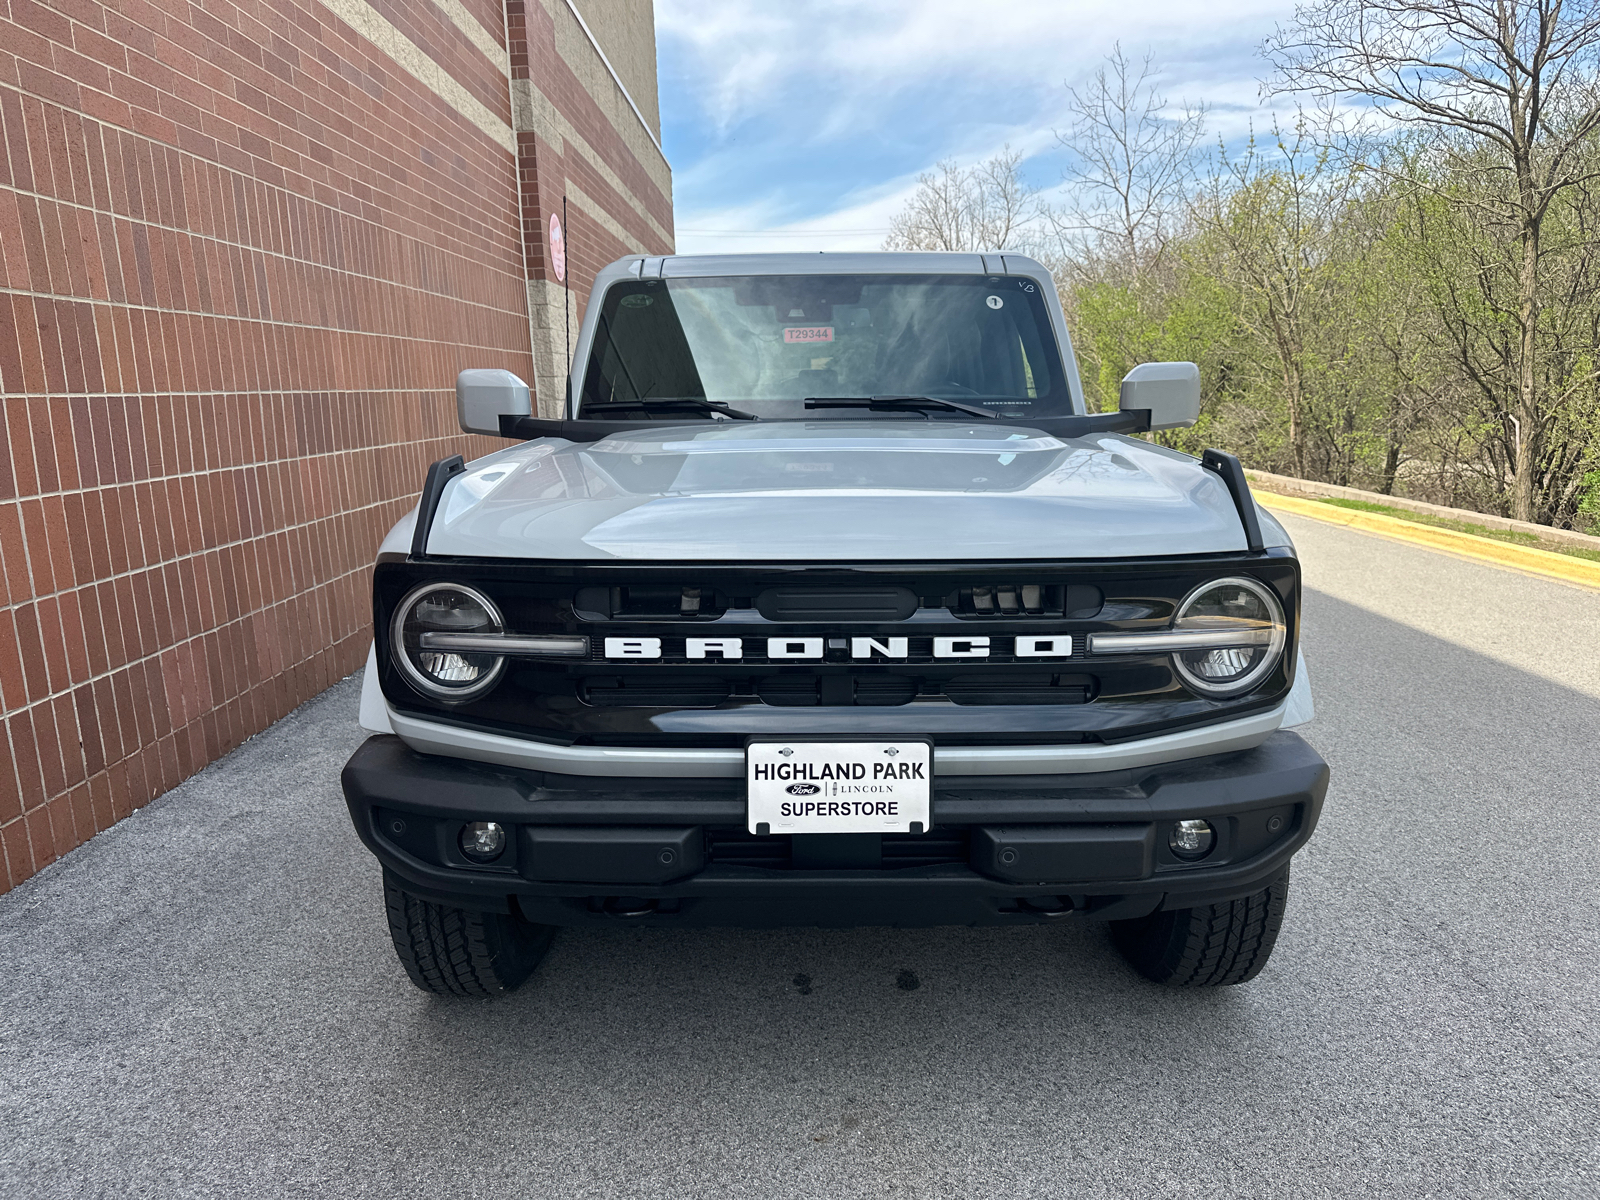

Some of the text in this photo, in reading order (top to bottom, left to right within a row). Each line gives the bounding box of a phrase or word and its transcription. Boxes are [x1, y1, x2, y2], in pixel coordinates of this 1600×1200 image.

[787, 328, 829, 339] T29344
[603, 635, 1073, 659] BRONCO
[754, 762, 925, 781] HIGHLAND PARK
[790, 783, 894, 795] Ford LINCOLN
[780, 801, 899, 816] SUPERSTORE
